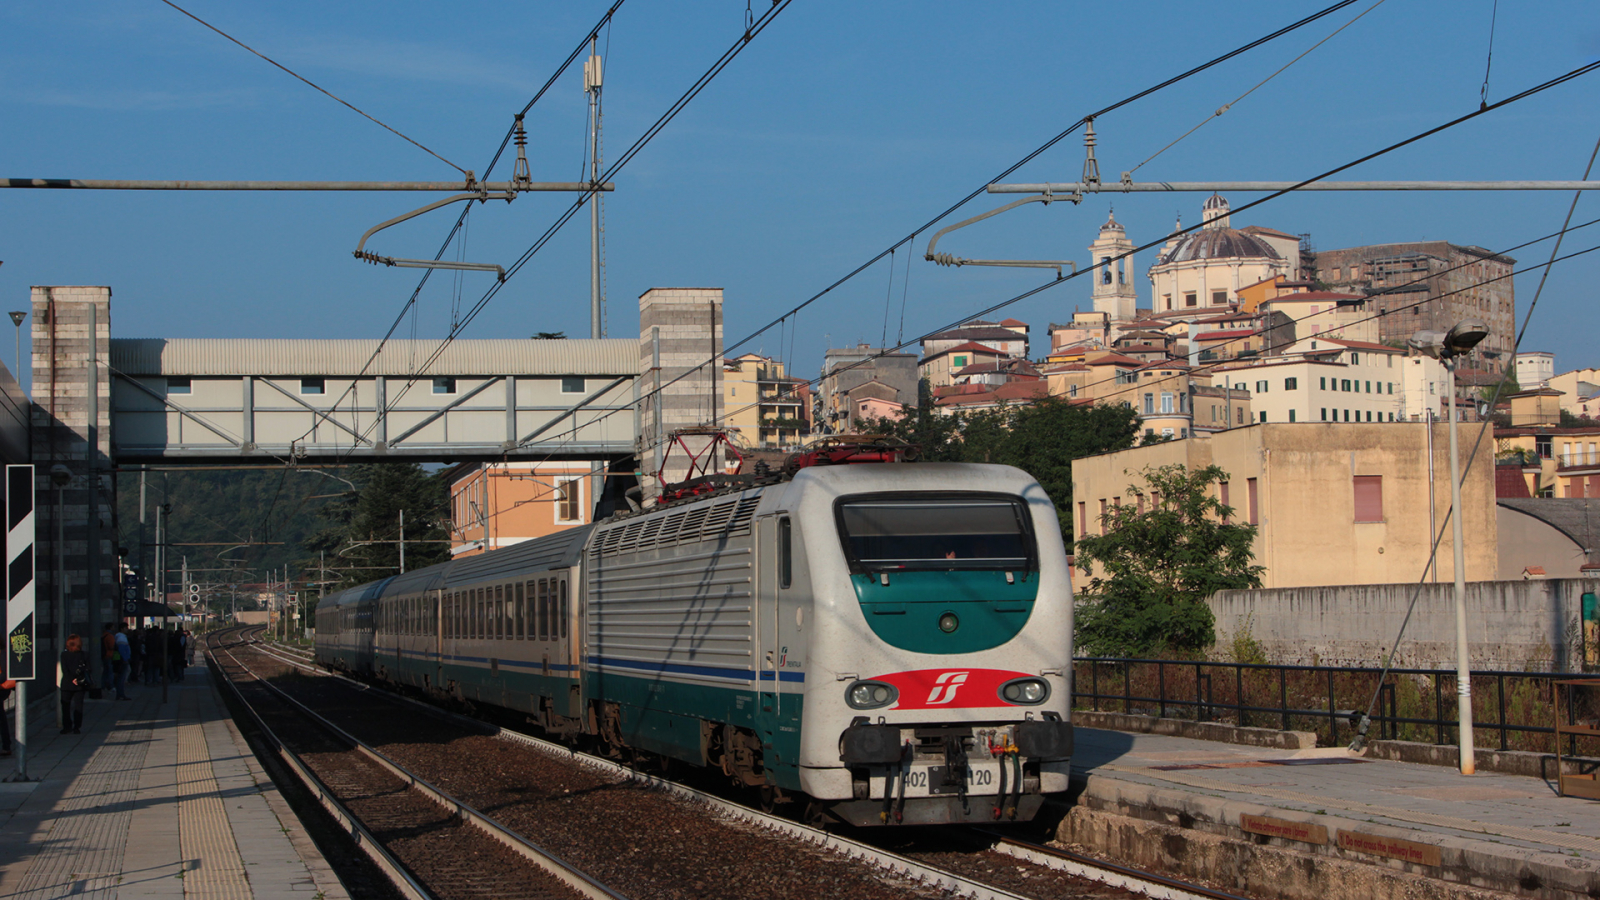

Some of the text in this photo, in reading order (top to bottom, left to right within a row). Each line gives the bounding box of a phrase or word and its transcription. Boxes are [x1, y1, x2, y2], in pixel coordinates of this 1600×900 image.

[903, 771, 927, 787] 402
[968, 769, 992, 785] 120
[1345, 834, 1423, 859] Do not cross the railway lines
